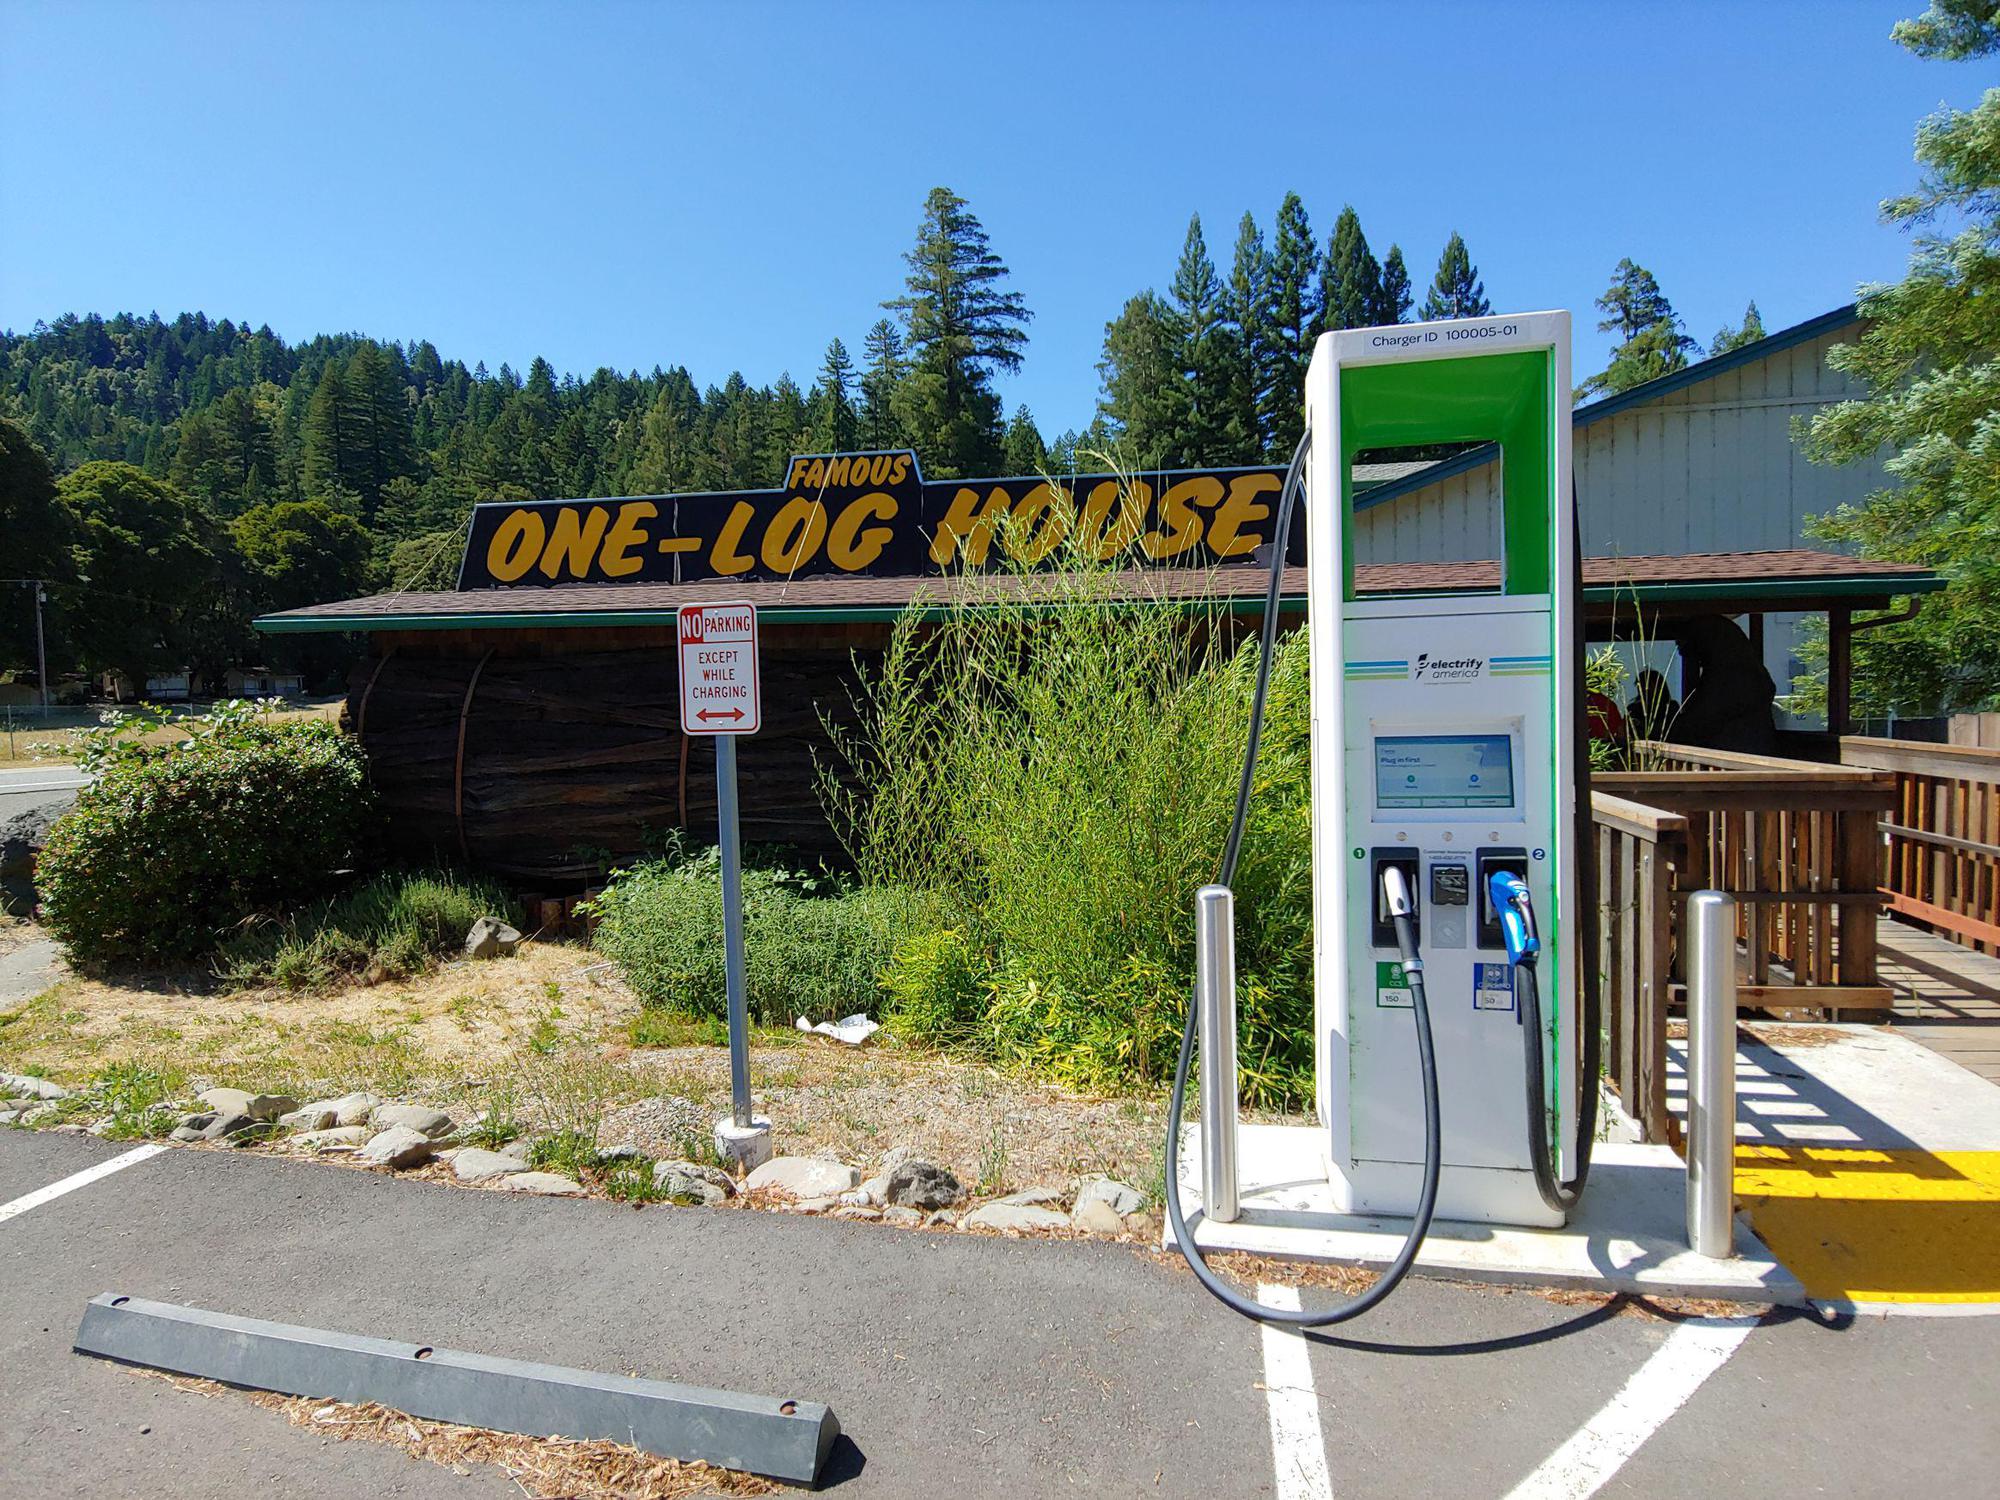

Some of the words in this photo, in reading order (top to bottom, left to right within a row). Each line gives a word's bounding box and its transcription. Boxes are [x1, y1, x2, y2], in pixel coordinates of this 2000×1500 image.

[1372, 334, 1422, 347] Charger
[1424, 331, 1438, 343] ID
[1446, 325, 1518, 341] 100005-01
[789, 454, 912, 490] FAMOUS
[487, 492, 899, 582] ONE-LOG
[929, 473, 1283, 566] HOUSE
[681, 613, 703, 639] NO
[704, 615, 751, 633] PARKING
[698, 650, 739, 664] EXCEPT
[1431, 658, 1483, 670] electrify
[703, 668, 735, 681] WHILE
[1432, 669, 1479, 679] america
[692, 685, 747, 699] CHARGING
[1384, 995, 1400, 1003] 150
